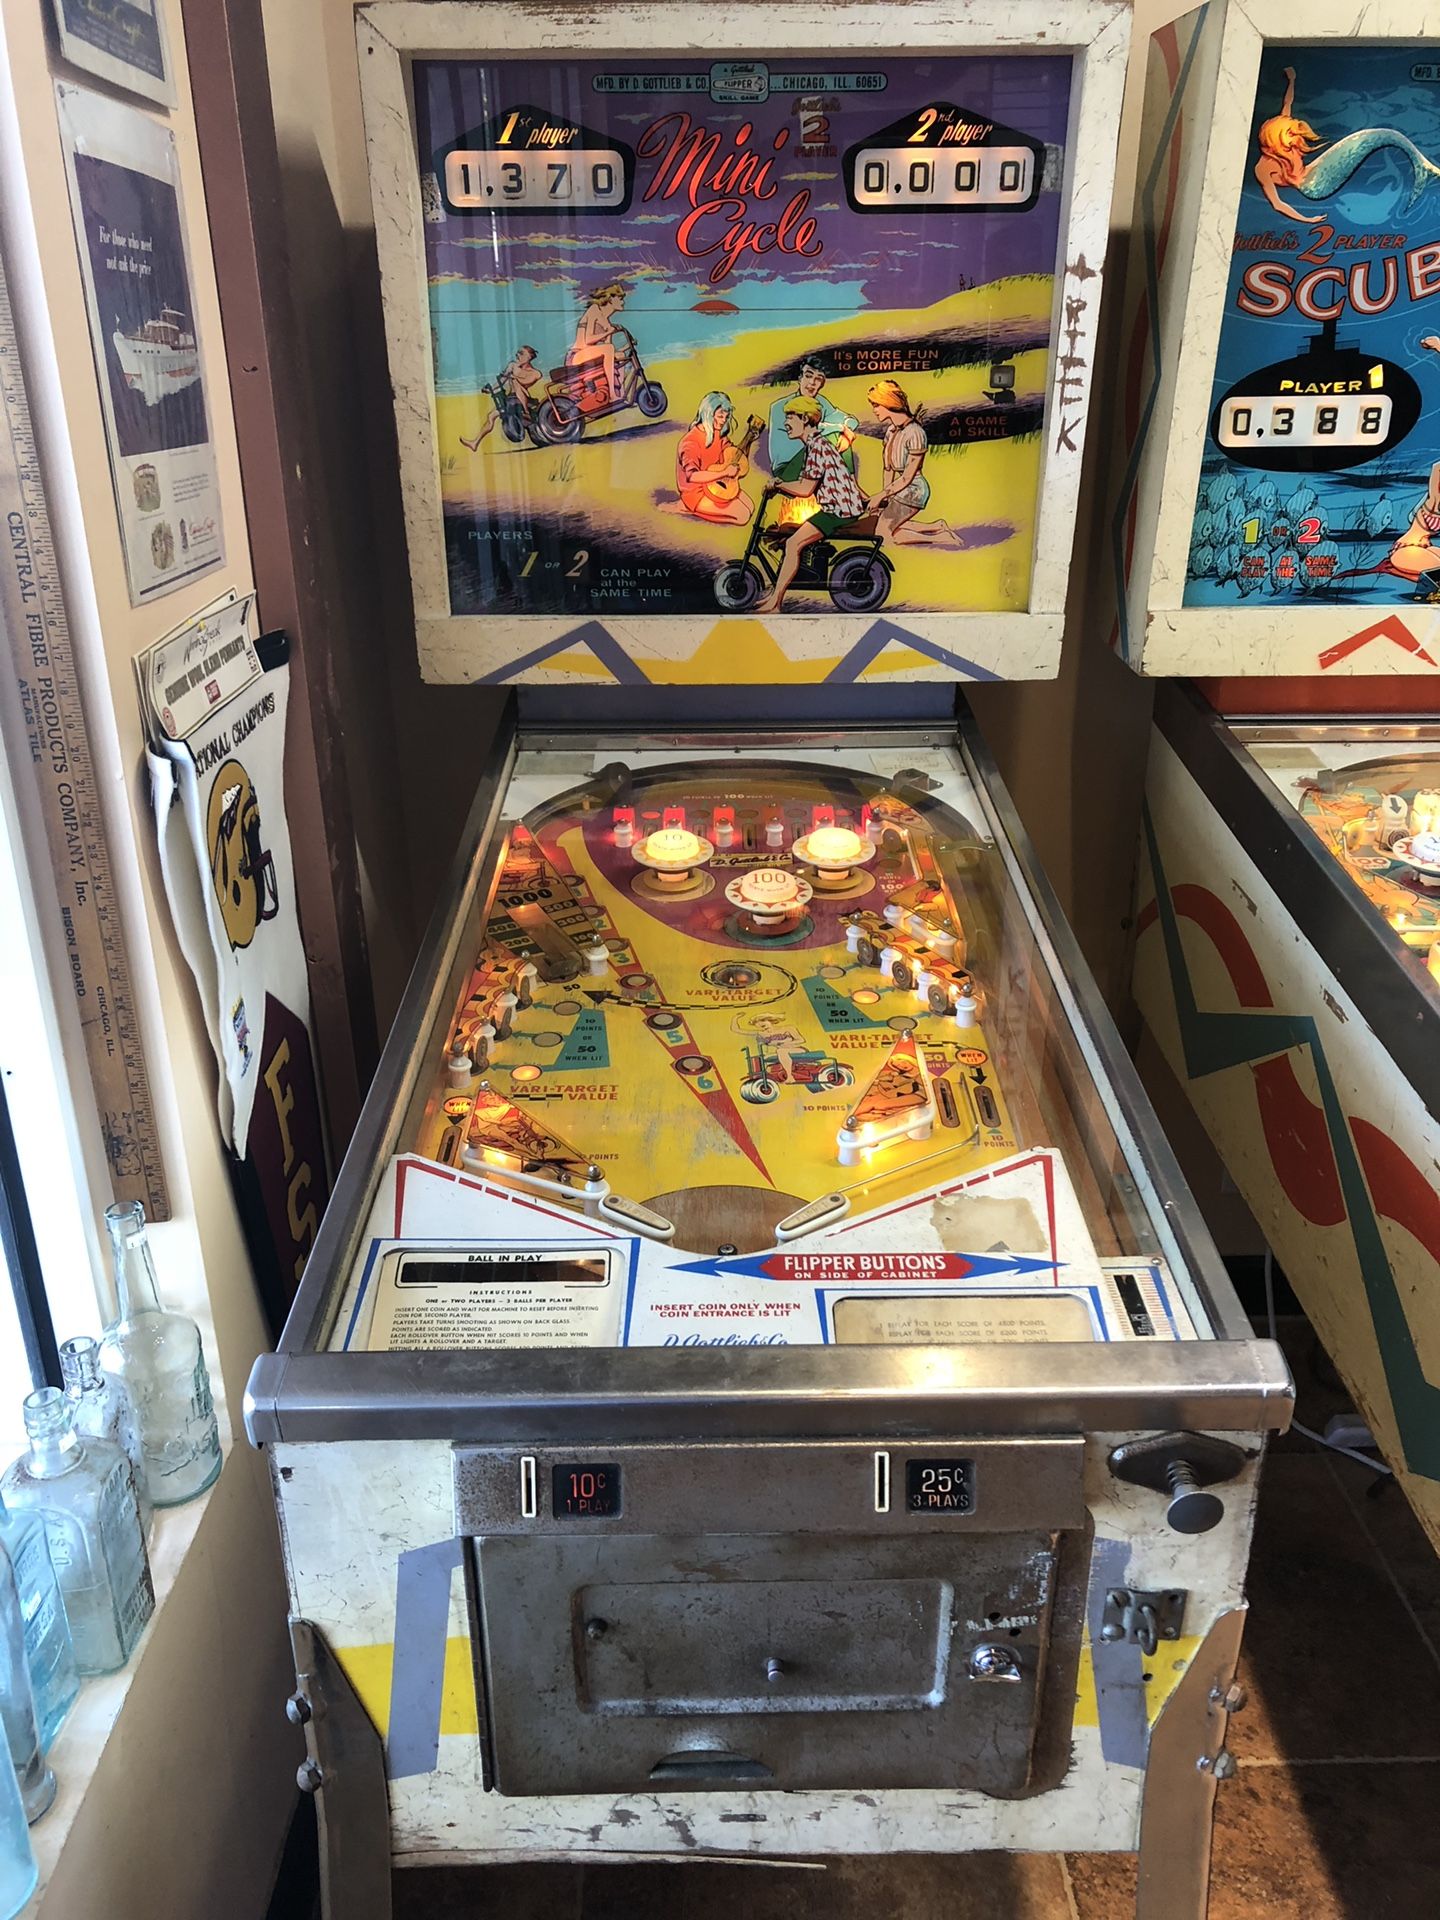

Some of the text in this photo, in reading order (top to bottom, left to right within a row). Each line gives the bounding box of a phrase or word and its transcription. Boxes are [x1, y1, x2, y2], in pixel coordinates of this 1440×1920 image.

[618, 77, 629, 90] BY
[642, 77, 682, 89] GOTTLIEB
[686, 77, 693, 89] &
[724, 80, 753, 89] FLIPPER
[834, 76, 850, 89] ILL.
[856, 76, 882, 89] 60651
[525, 122, 579, 149] player
[803, 115, 830, 143] 2
[938, 119, 993, 147] player
[636, 112, 778, 210] Mini
[99, 226, 153, 252] For those who need
[676, 188, 824, 284] Cycle
[1296, 224, 1336, 265] 2
[1333, 234, 1408, 250] PLAYER
[106, 255, 138, 273] not ask the
[1237, 240, 1440, 321] SCUB
[834, 350, 939, 361] It's MORE FUN
[838, 360, 931, 371] to COMPETE
[1280, 364, 1384, 393] PLAYER 1
[952, 416, 1008, 426] A GAME
[949, 426, 1009, 437] of SKILL
[468, 530, 533, 541] PLAYERS
[1242, 517, 1321, 544] 1 OR 2
[518, 550, 590, 578] 1 OR 2
[1244, 556, 1265, 566] CAN
[1280, 556, 1294, 566] AT
[1306, 556, 1337, 566] SAME
[600, 568, 671, 578] CAN PLAY
[1277, 568, 1295, 578] THE
[1308, 567, 1333, 577] TIME
[616, 578, 637, 587] the
[590, 588, 672, 598] SAME TIME
[7, 512, 89, 907] CENTRAL FIBRE PRODUCTS COMPANY, Inc.
[18, 678, 43, 763] ATLAS TILE
[232, 692, 275, 747] CHAMPIONS
[753, 873, 786, 884] 100
[498, 888, 553, 909] 1000
[544, 901, 578, 913] 500
[557, 914, 586, 927] 300
[595, 920, 607, 929] 2
[488, 923, 517, 934] 400
[505, 938, 531, 948] 200
[573, 932, 595, 943] 100
[62, 907, 86, 997] BISON BOARD
[614, 953, 630, 963] 3
[563, 984, 581, 992] 50
[96, 986, 110, 1035] CHICAGO,
[666, 1030, 683, 1043] 5
[924, 1053, 943, 1061] 50
[697, 1076, 713, 1089] 6
[264, 1037, 317, 1281] FS
[784, 1255, 946, 1271] FLIPPER BUTTONS
[881, 1271, 938, 1279] CABINET
[567, 1500, 609, 1513] 1 PLAY
[913, 1495, 969, 1507] 3 PLAYS
